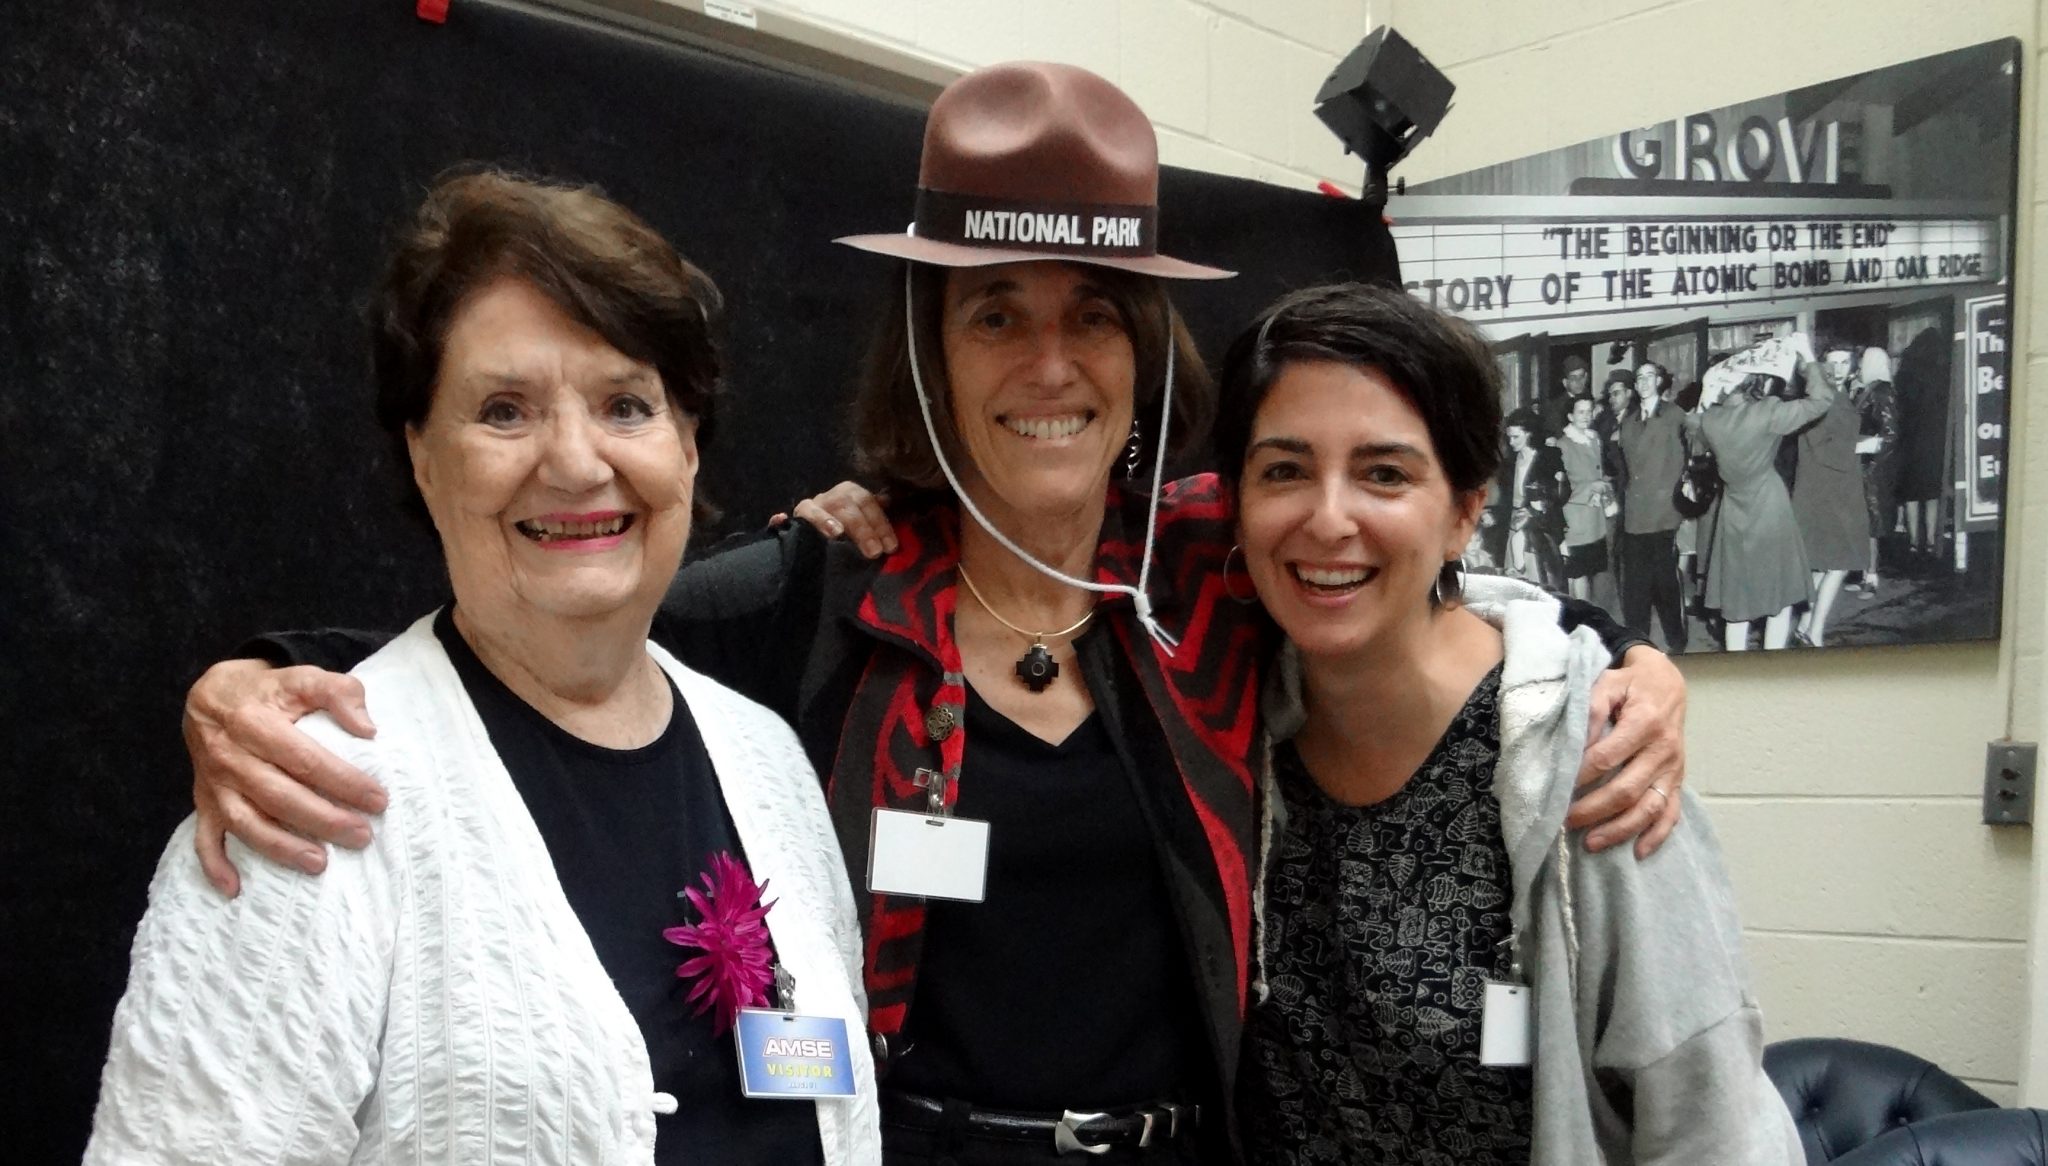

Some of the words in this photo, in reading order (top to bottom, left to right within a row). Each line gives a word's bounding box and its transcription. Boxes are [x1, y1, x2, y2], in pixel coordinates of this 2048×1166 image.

[964, 209, 1086, 245] NATIONAL
[1091, 215, 1142, 247] PARK
[1627, 224, 1757, 257] BEGINNING
[1767, 223, 1797, 251] OR
[1808, 223, 1843, 249] THE
[1541, 271, 1581, 305] OF
[1602, 268, 1653, 301] THE
[1671, 262, 1757, 297] ATOMIC
[1774, 259, 1831, 291] BOMB
[1844, 257, 1882, 285] AND
[1895, 255, 1929, 280] OAK
[1938, 253, 1981, 278] RIDGE
[763, 1037, 833, 1059] AMSE
[767, 1063, 833, 1078] VISITOR
